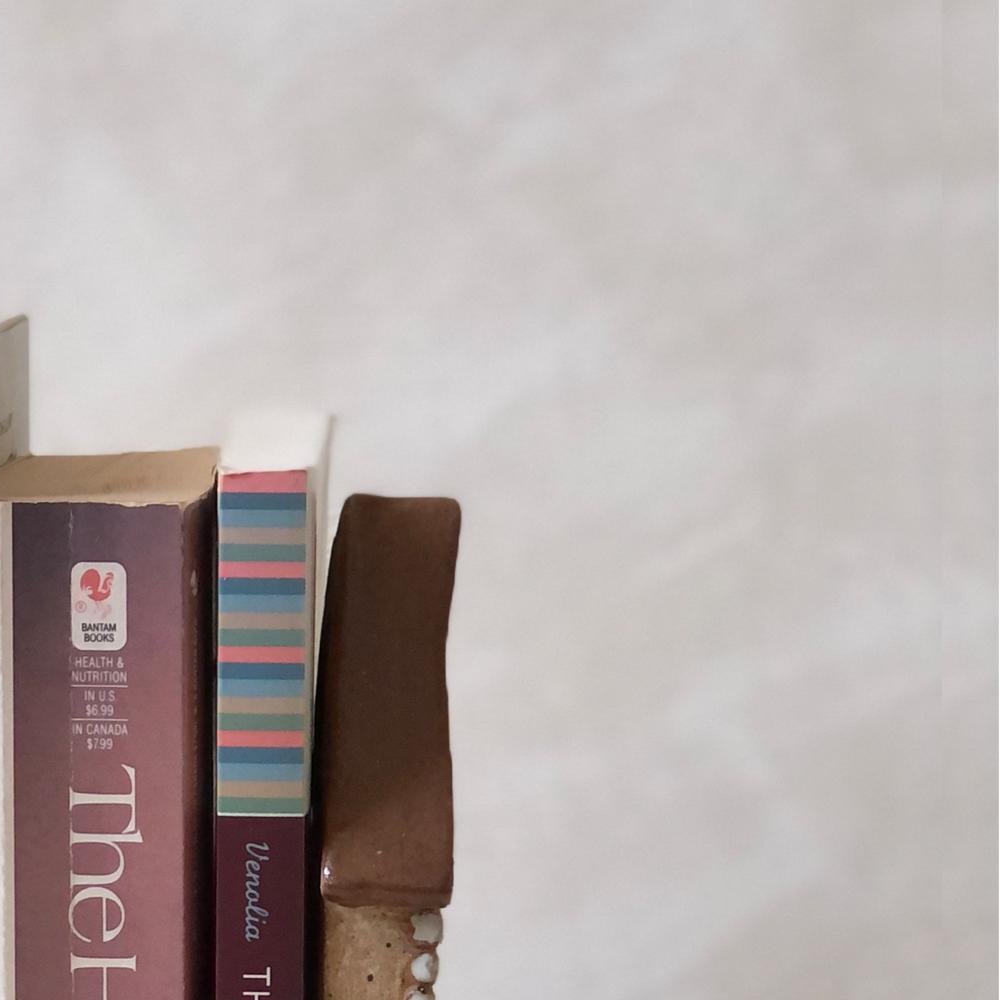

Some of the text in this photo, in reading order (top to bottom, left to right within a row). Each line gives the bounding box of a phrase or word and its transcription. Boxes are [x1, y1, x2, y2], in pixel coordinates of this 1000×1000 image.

[81, 622, 117, 632] BANTAM
[83, 633, 115, 643] BOOKS
[74, 656, 125, 669] HEALTH &
[71, 670, 128, 683] NUTRITION
[84, 690, 95, 701] IN
[72, 723, 128, 735] IN CANADA
[68, 764, 144, 943] The
[245, 842, 270, 942] Venolia
